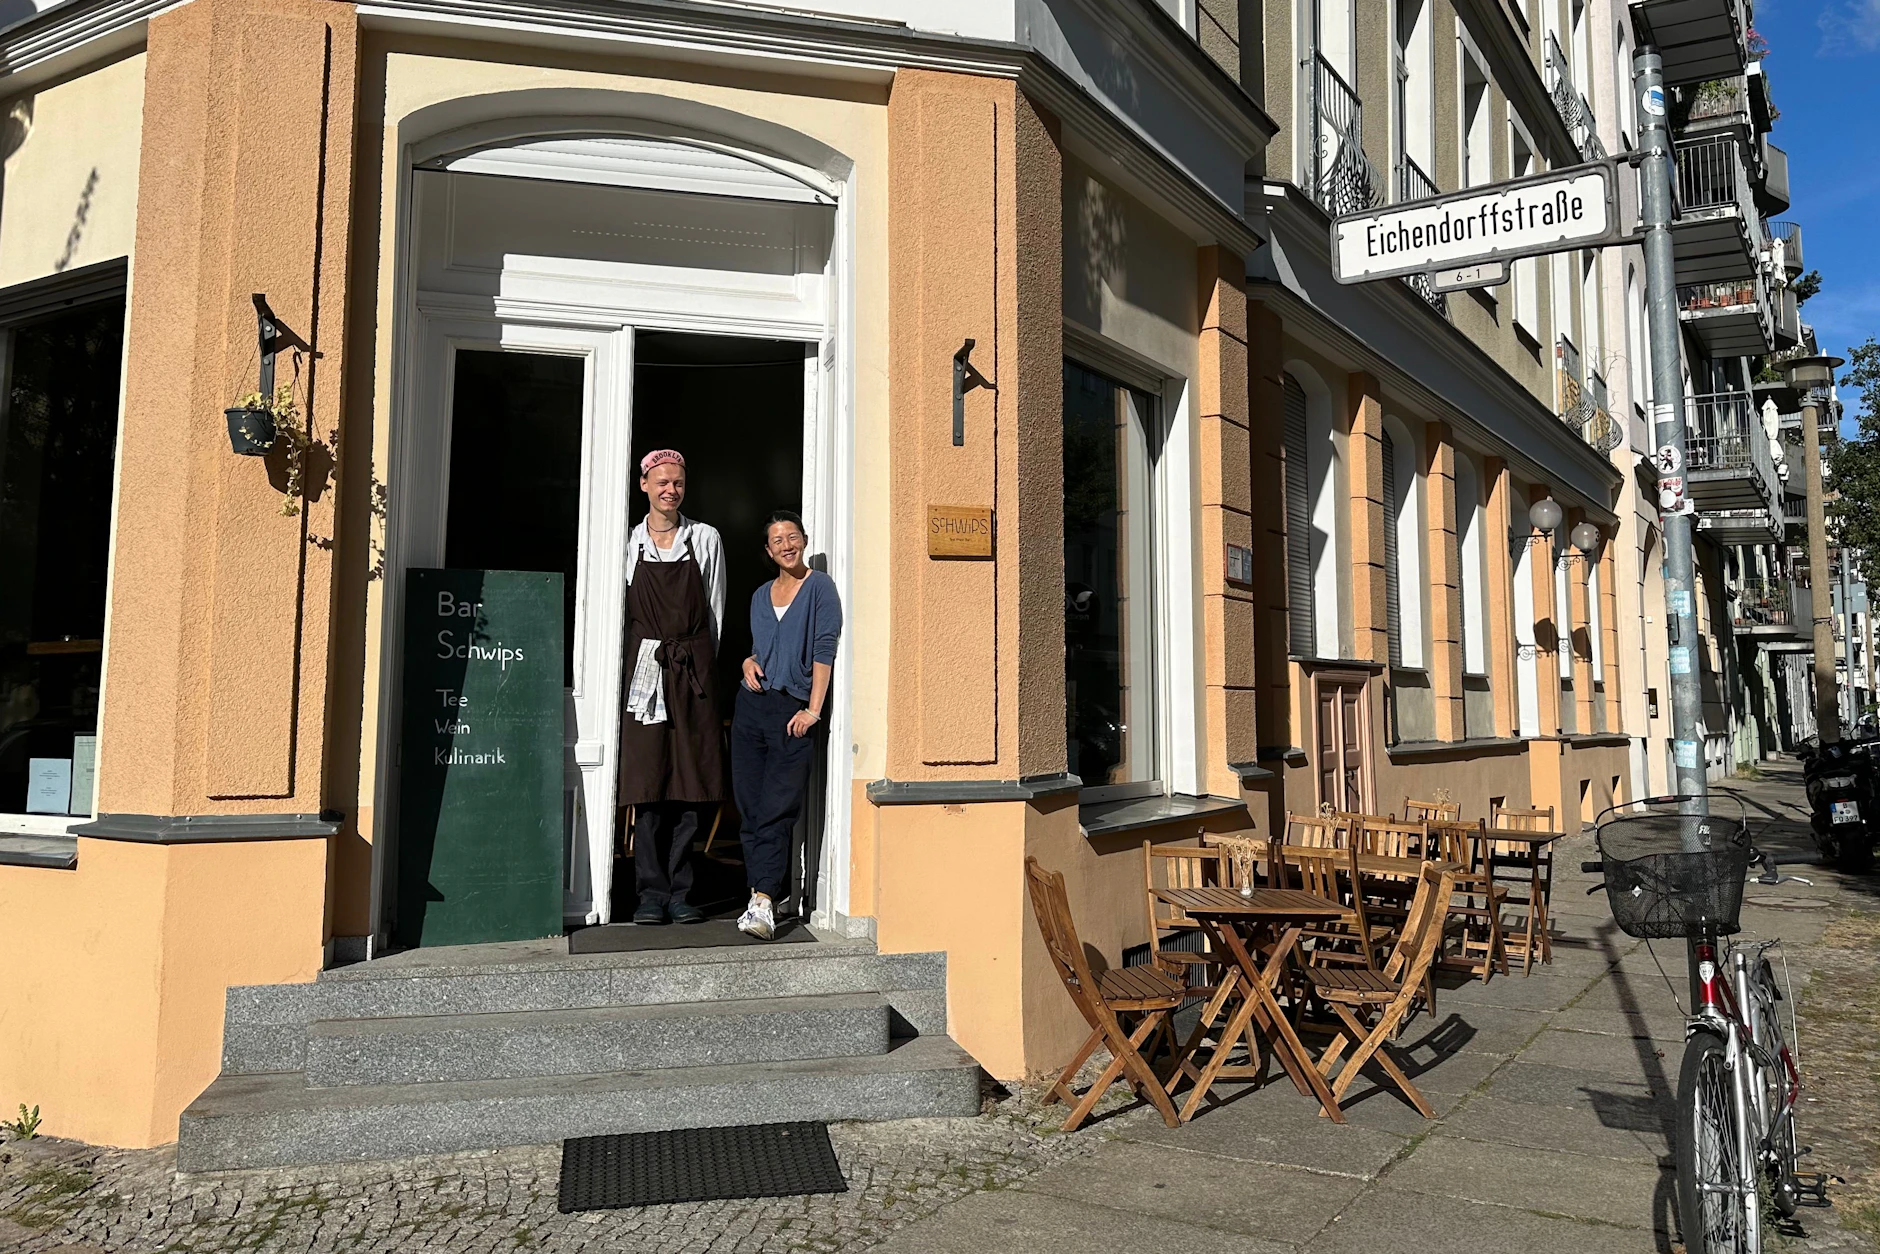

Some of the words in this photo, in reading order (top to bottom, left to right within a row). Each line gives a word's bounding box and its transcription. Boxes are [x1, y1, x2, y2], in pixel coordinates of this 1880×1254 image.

[1367, 190, 1584, 257] Eichendorffstraße
[437, 591, 483, 618] Bar
[437, 629, 524, 671] Schwips
[435, 688, 469, 708] Tee
[434, 718, 471, 735] Wein
[434, 747, 506, 766] Kulinarik
